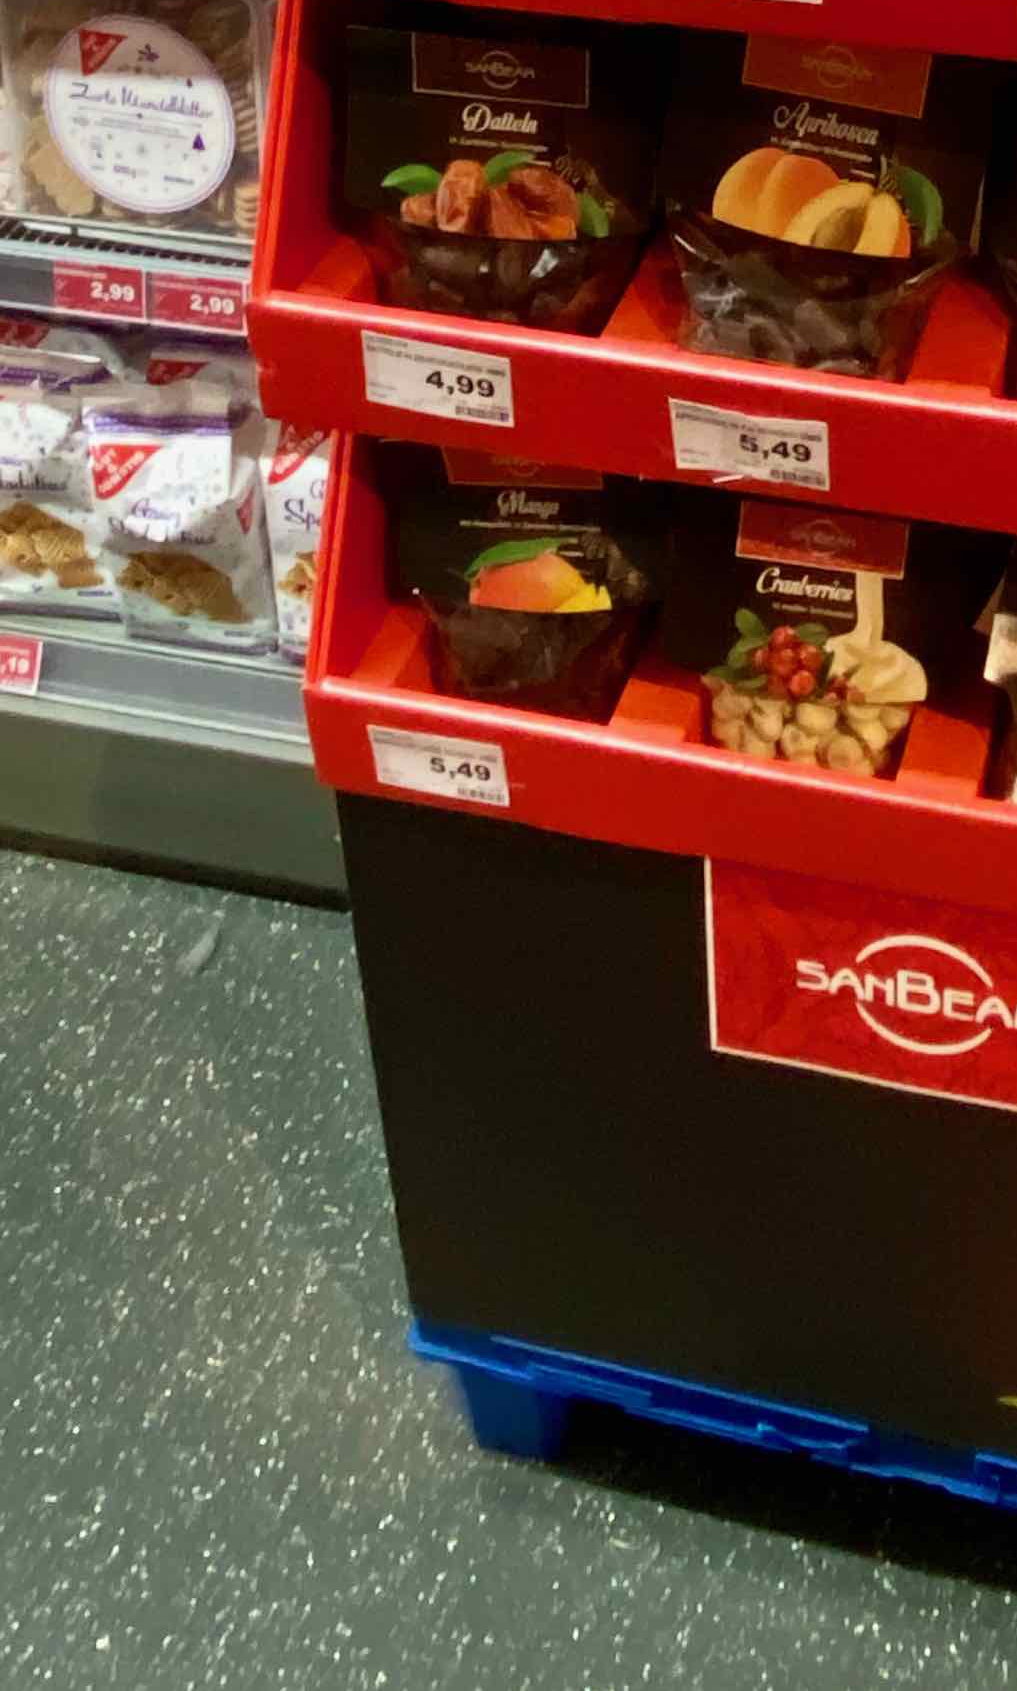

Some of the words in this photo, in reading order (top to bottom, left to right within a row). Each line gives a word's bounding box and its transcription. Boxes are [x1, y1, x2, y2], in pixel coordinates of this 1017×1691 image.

[461, 102, 539, 135] Datteln
[89, 281, 136, 304] 2,99
[190, 294, 235, 315] 2,99
[426, 370, 495, 399] 4,99
[740, 433, 812, 463] 5,49
[756, 567, 854, 602] Cranberries
[429, 756, 491, 781] 5,49
